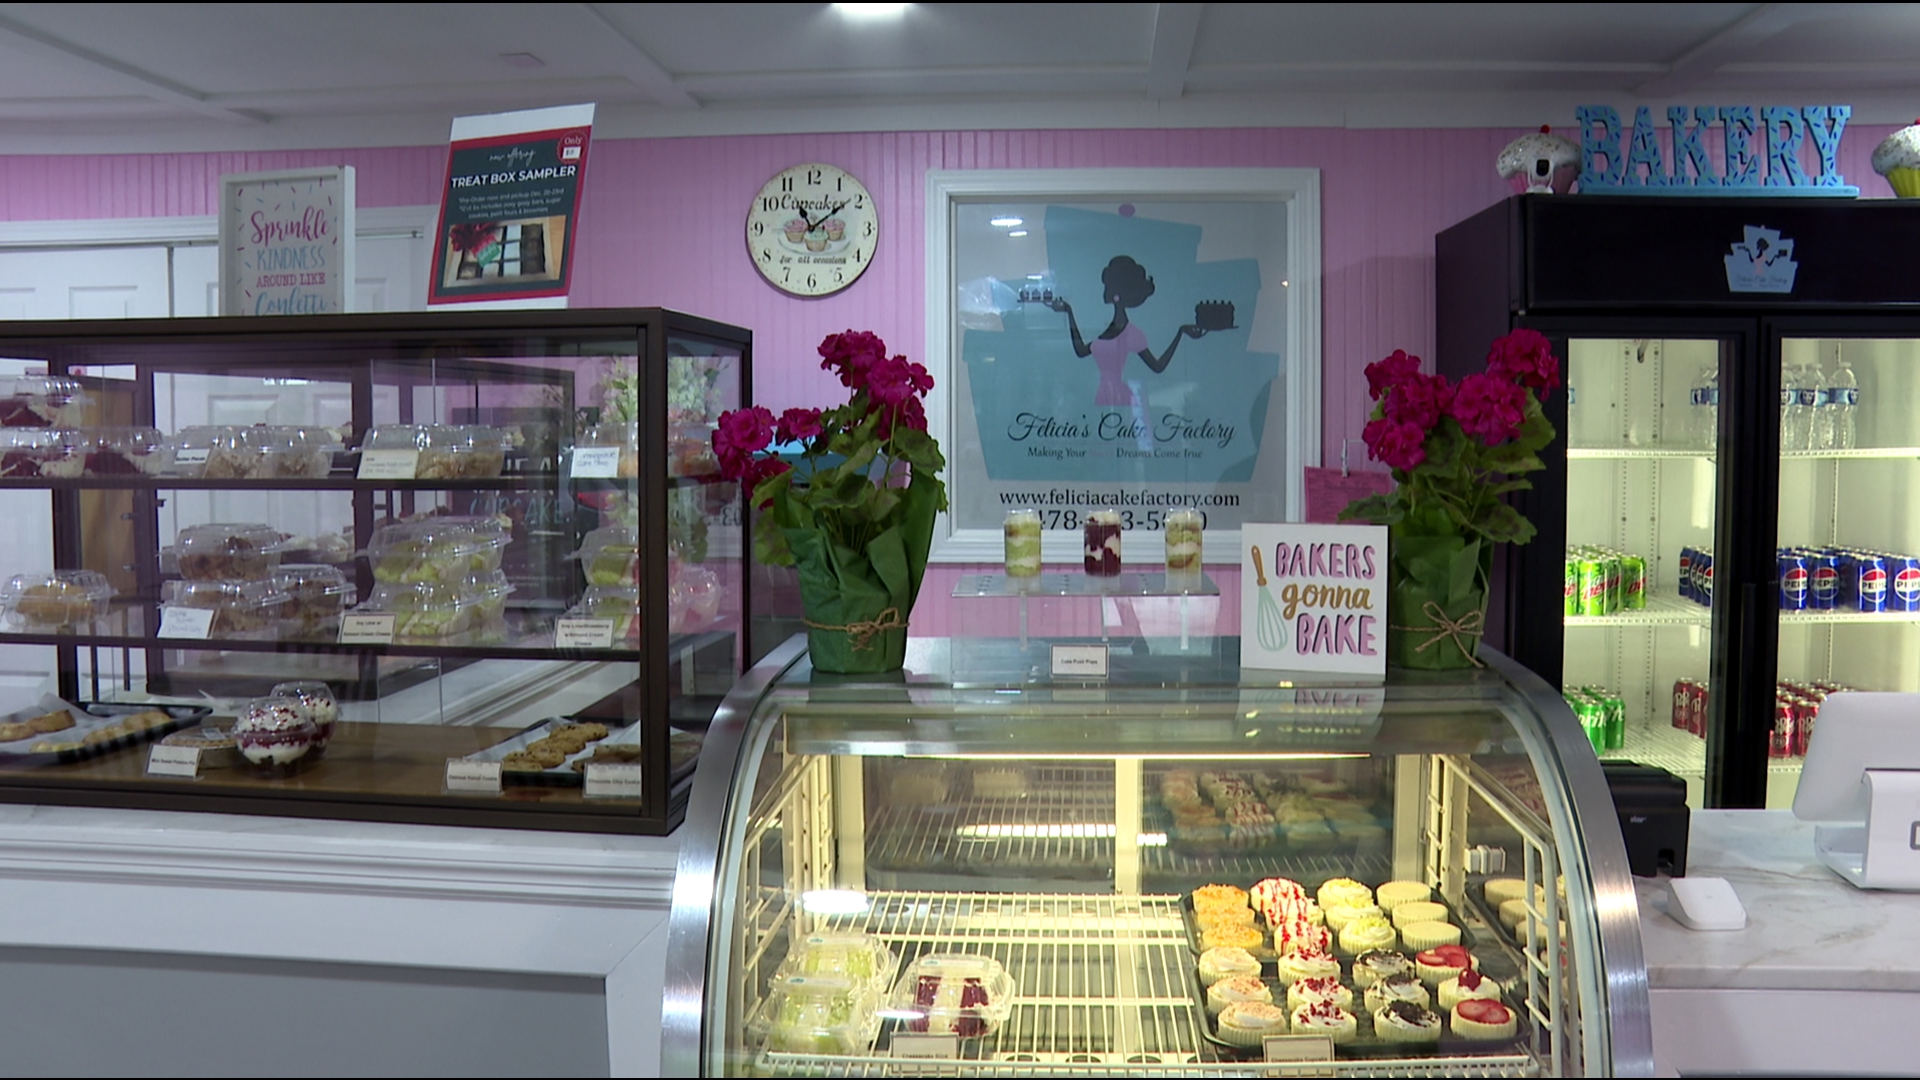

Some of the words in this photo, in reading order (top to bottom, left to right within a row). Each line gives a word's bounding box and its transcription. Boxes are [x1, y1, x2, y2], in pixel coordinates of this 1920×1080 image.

[1575, 105, 1852, 187] BAKERY
[451, 174, 490, 189] TREAT
[490, 171, 516, 185] BOX
[518, 165, 577, 182] SAMPLER
[781, 176, 793, 192] 11
[806, 169, 822, 186] 12
[837, 176, 842, 192] 1
[762, 195, 779, 212] 10
[781, 193, 846, 211] Cupcakes
[854, 194, 864, 210] 2
[251, 205, 330, 247] Sprinkle
[753, 221, 764, 237] 9
[862, 221, 872, 238] 3
[256, 245, 326, 271] KINDNESS
[761, 248, 772, 264] 8
[797, 256, 811, 265] all
[851, 248, 861, 263] 4
[256, 274, 297, 288] AROUND
[299, 272, 326, 286] LIKE
[782, 266, 792, 283] 7
[806, 273, 817, 289] 6
[834, 268, 843, 283] 5
[255, 286, 328, 316] Confetti
[1007, 412, 1090, 441] Felicia's
[1098, 411, 1148, 441] Cake
[1153, 413, 1235, 449] Factory
[1028, 446, 1064, 461] Making
[1065, 447, 1087, 458] Your
[1116, 447, 1152, 459] Dreams
[1153, 448, 1181, 459] Come
[1183, 447, 1204, 459] True
[1000, 488, 1241, 509] www.feliciacakefactory.com
[1275, 541, 1377, 580] BAKERS
[1281, 583, 1375, 621] gonna
[1296, 612, 1379, 656] BAKE
